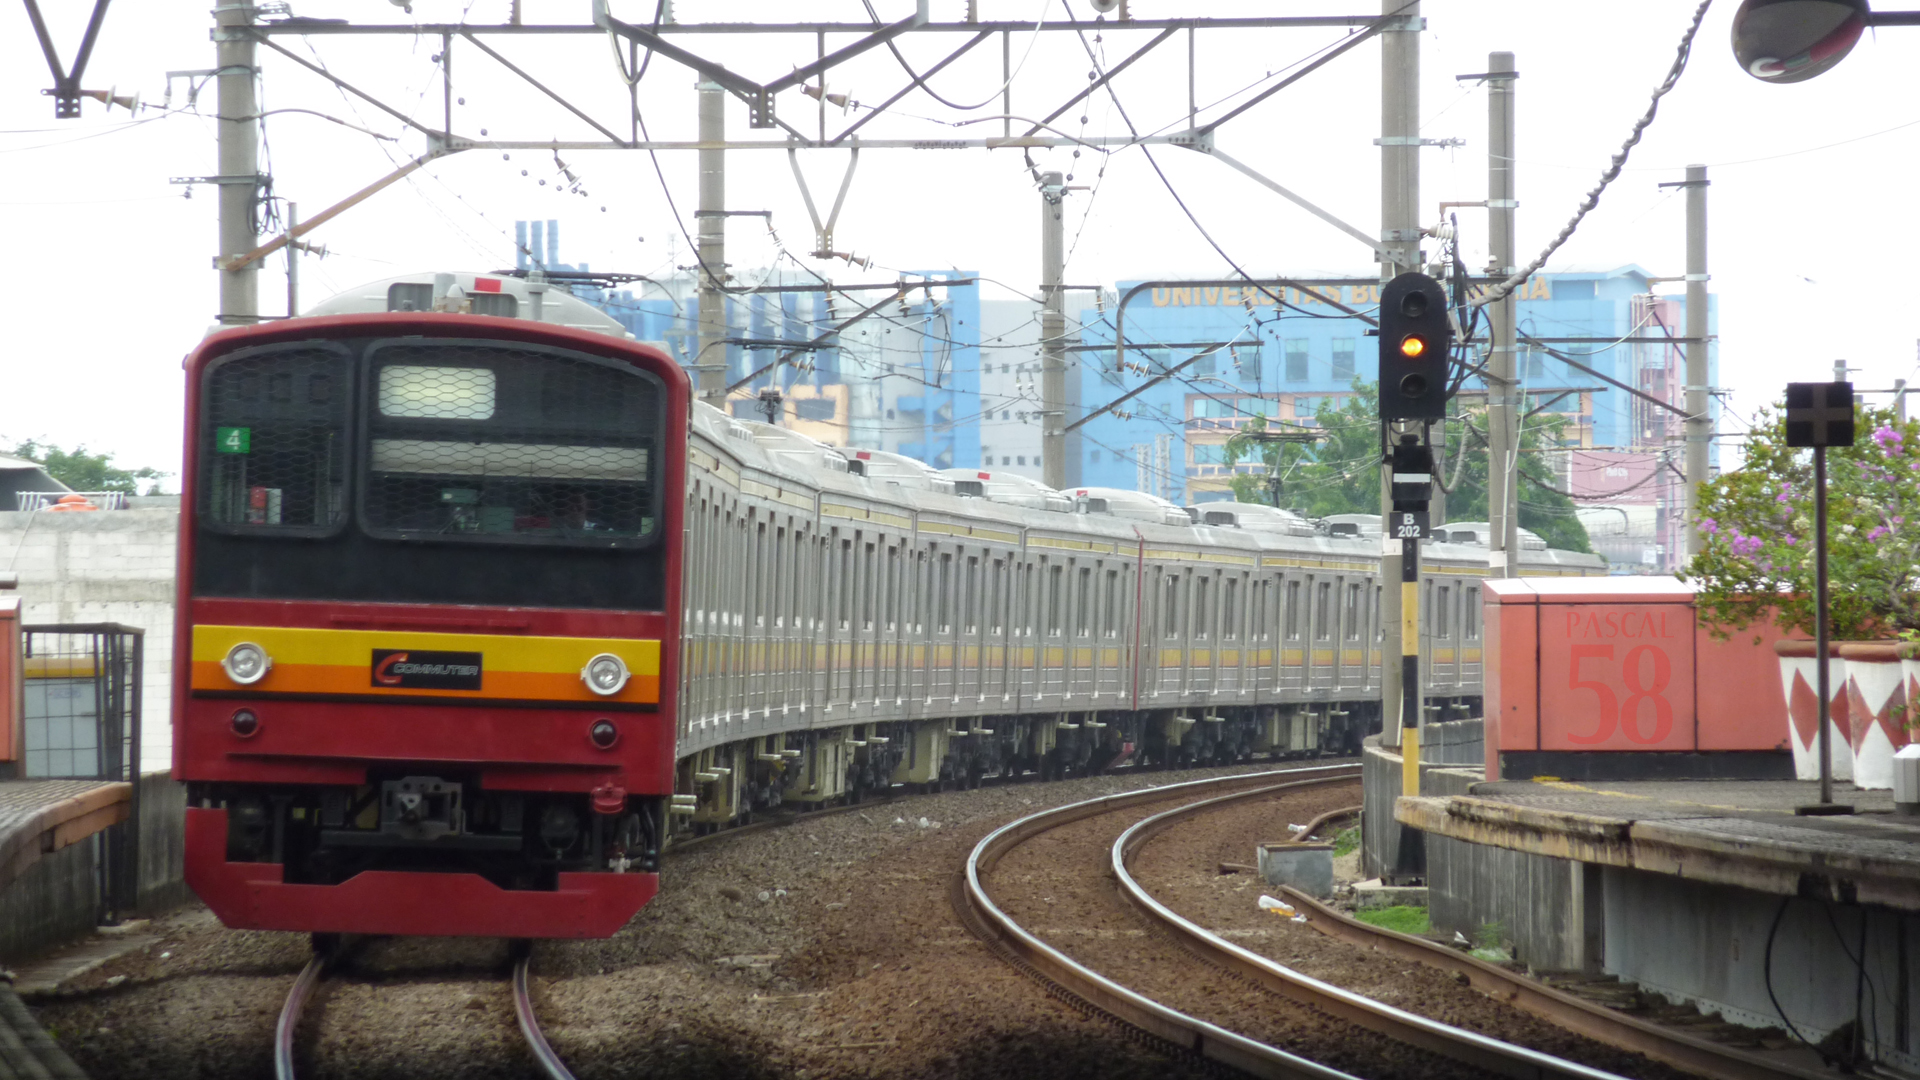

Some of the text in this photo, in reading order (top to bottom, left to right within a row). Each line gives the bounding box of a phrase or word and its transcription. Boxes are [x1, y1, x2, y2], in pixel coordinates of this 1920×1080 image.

[226, 429, 241, 451] 4
[1403, 513, 1415, 525] B
[1397, 525, 1421, 538] 202
[393, 663, 479, 676] COMMUTER
